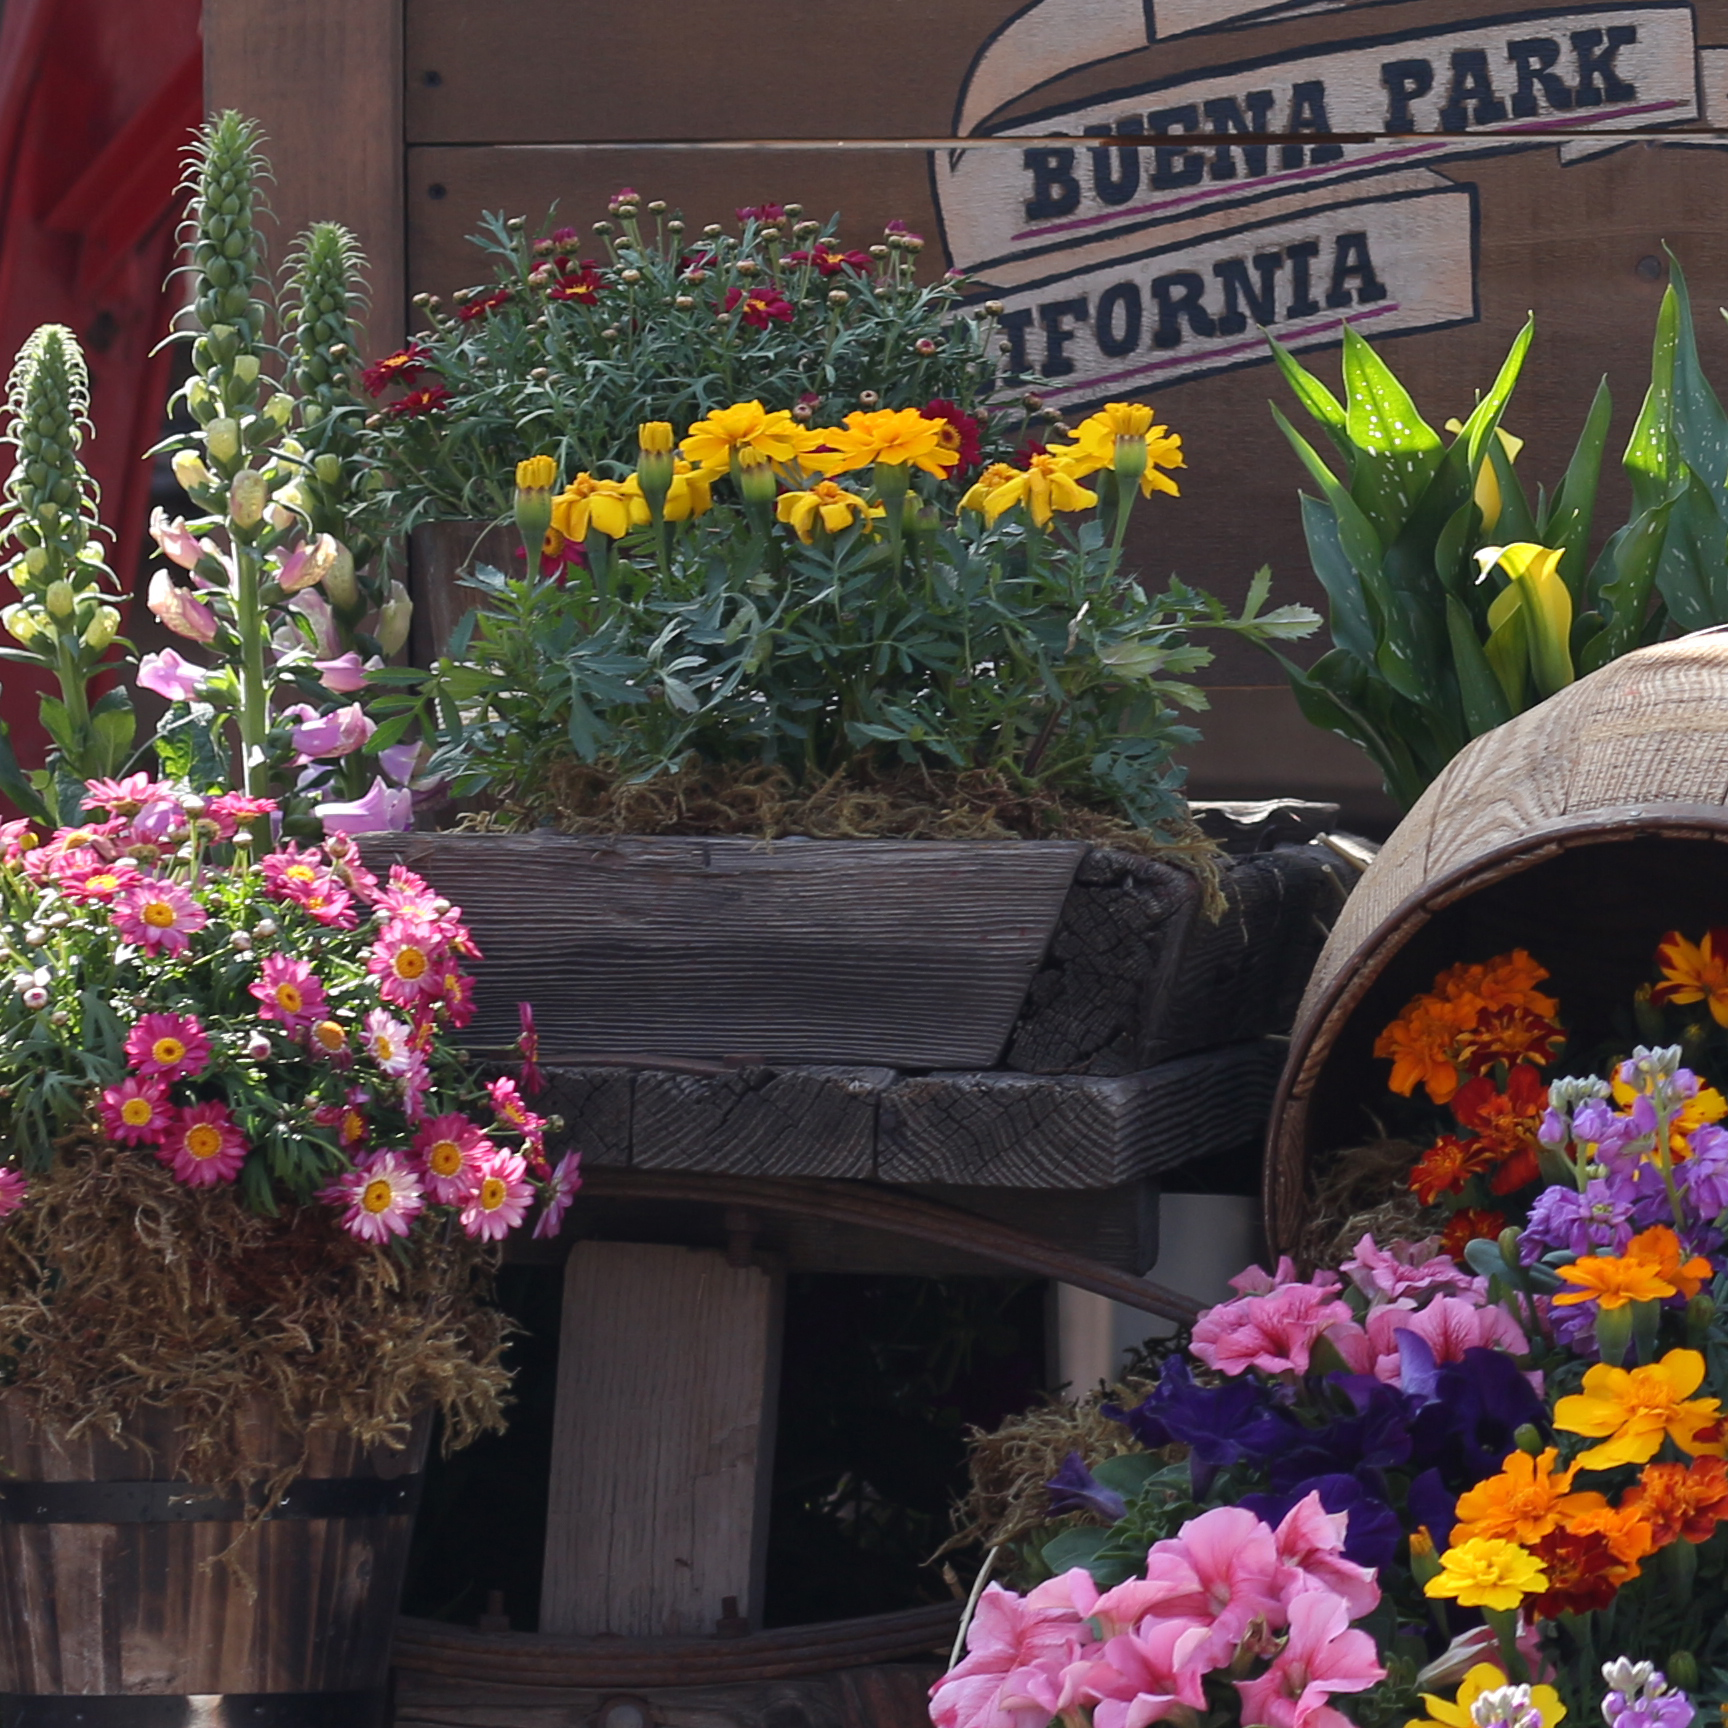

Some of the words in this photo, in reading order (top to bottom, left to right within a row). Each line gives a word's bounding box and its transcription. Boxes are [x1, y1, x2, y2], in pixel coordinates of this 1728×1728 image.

[1023, 80, 1344, 222] BUENA
[1382, 24, 1639, 133] PARK
[965, 228, 1388, 392] IFORNIA
